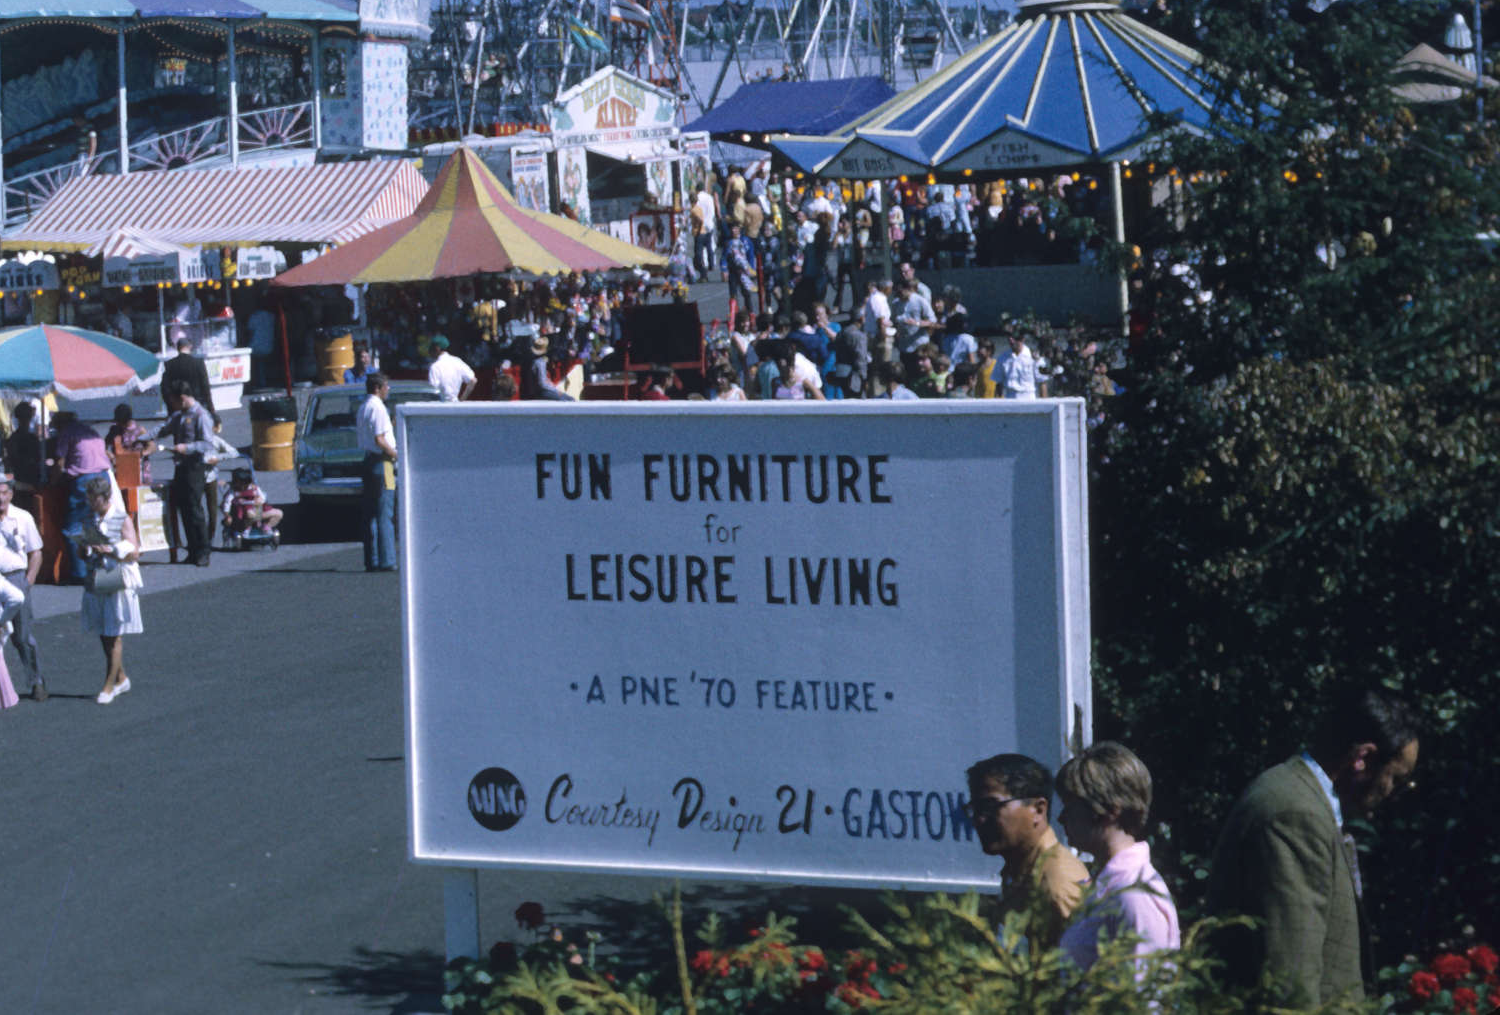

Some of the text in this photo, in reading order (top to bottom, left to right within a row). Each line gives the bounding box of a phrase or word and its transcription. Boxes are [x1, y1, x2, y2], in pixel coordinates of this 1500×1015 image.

[991, 142, 1029, 155] FISH
[997, 153, 1041, 165] CHIPS
[535, 453, 894, 505] FUN FURNITURE
[704, 513, 743, 544] for
[565, 553, 900, 607] LEISURE LIVING
[586, 670, 879, 713] A PNE '70 FEATURE
[545, 772, 979, 853] Courtesy Design 21 GASTOW
